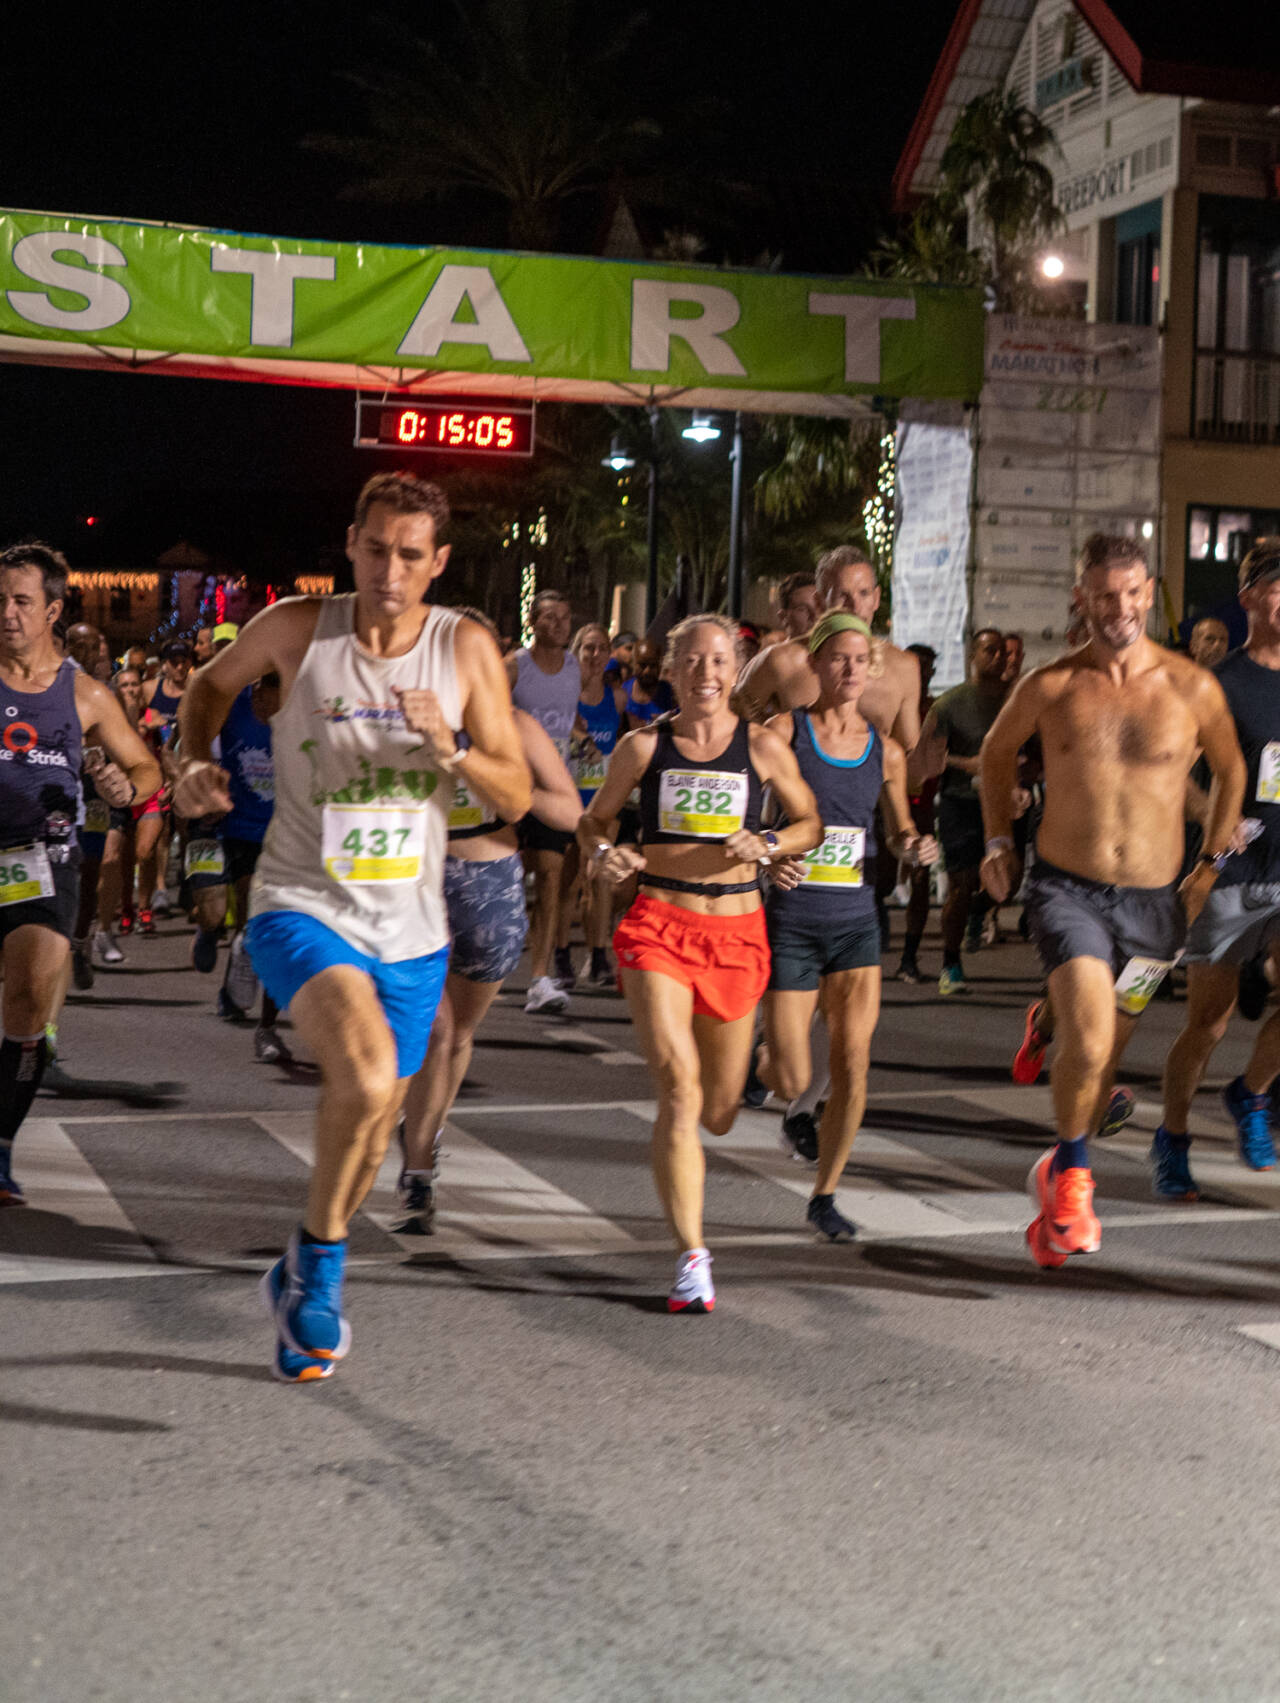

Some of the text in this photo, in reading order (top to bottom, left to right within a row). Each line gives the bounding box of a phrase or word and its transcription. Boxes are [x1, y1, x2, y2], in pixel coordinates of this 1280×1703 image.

[5, 231, 916, 384] START
[399, 411, 513, 447] 0:15:05
[27, 749, 68, 766] Stride
[675, 788, 732, 814] 282
[342, 828, 412, 857] 437
[804, 844, 852, 865] 252
